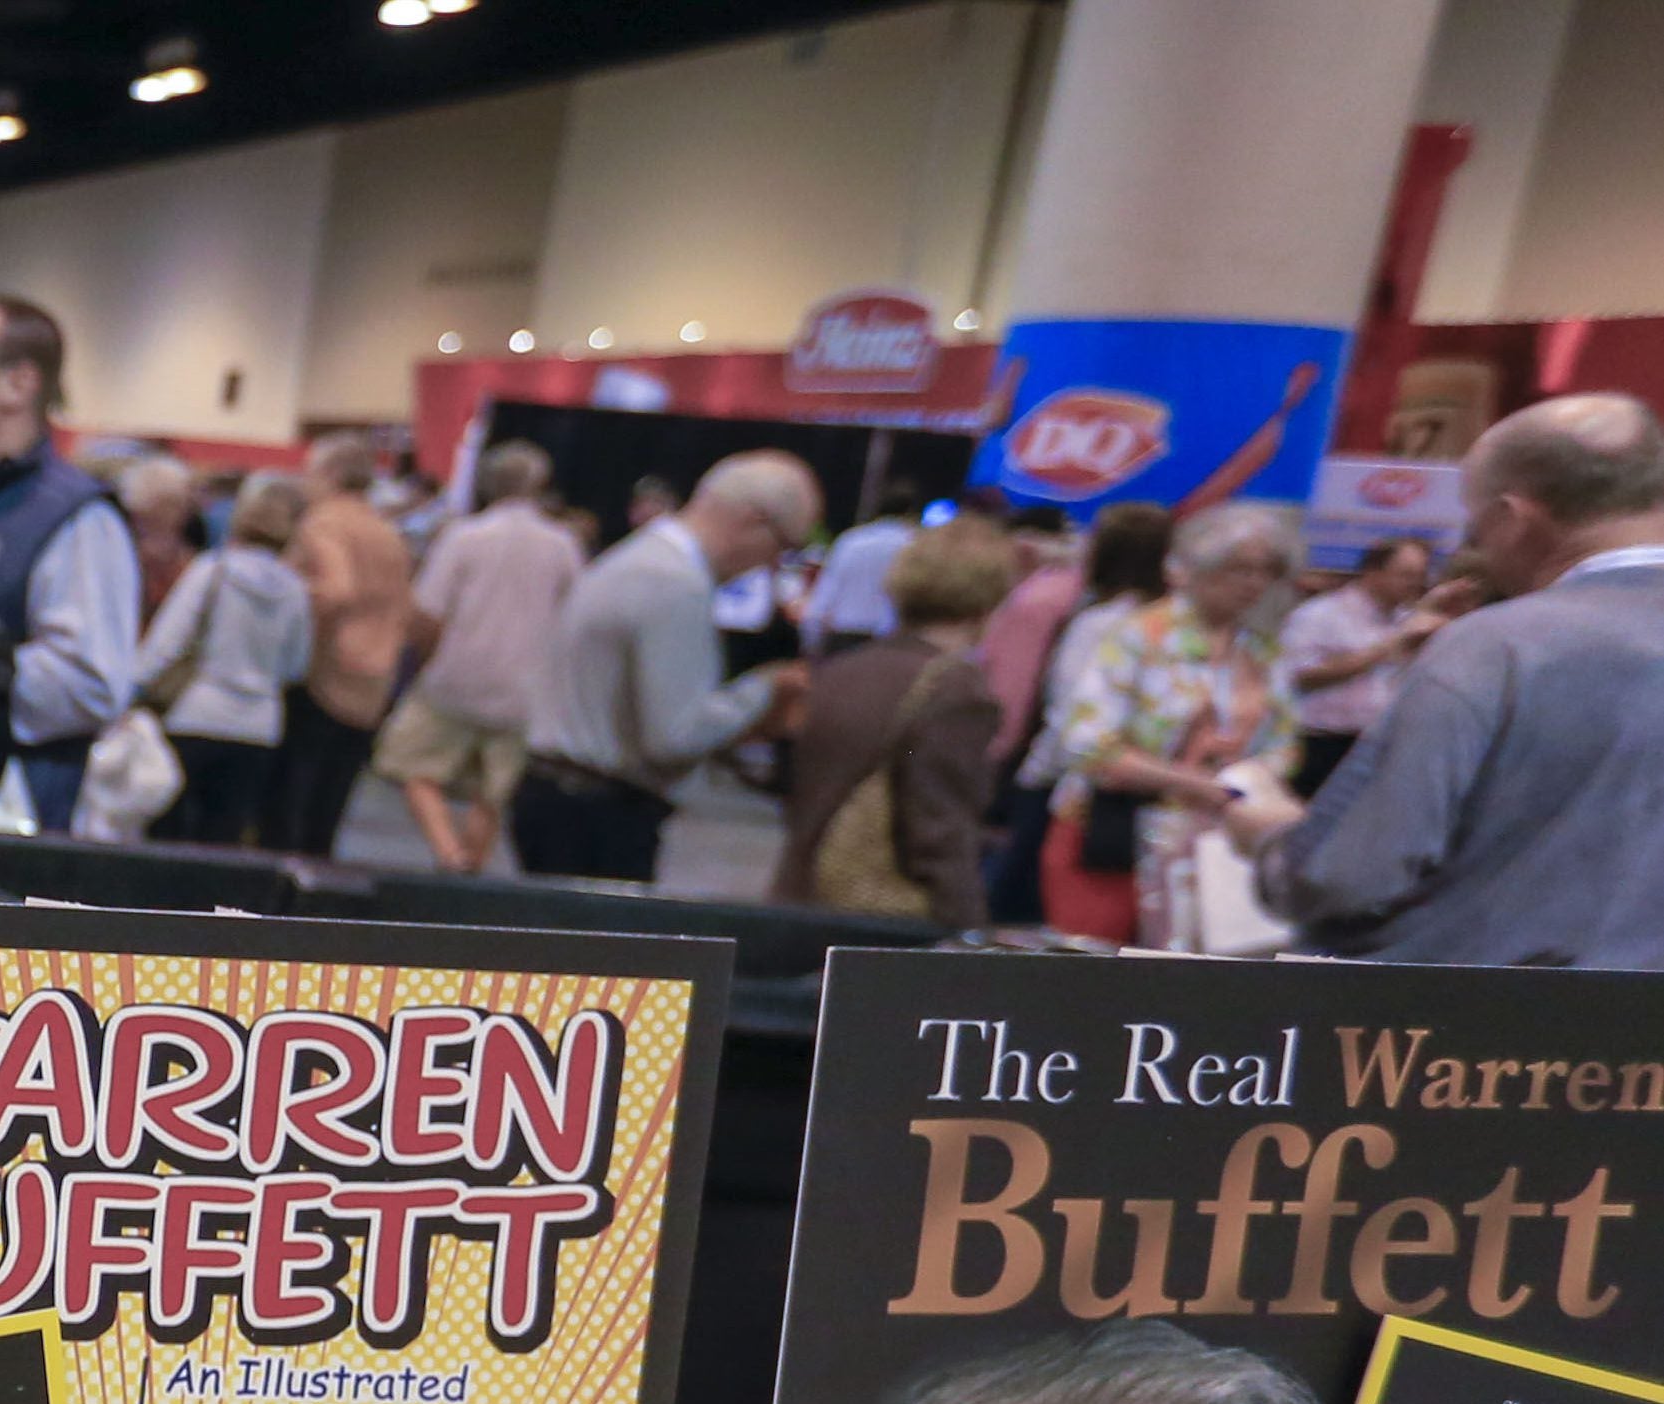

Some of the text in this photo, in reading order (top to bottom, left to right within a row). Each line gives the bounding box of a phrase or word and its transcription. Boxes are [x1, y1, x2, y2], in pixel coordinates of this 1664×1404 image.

[918, 1018, 1663, 1111] The Real Warren
[887, 1118, 1635, 1320] Buffett
[166, 1358, 469, 1402] An Illustrated
